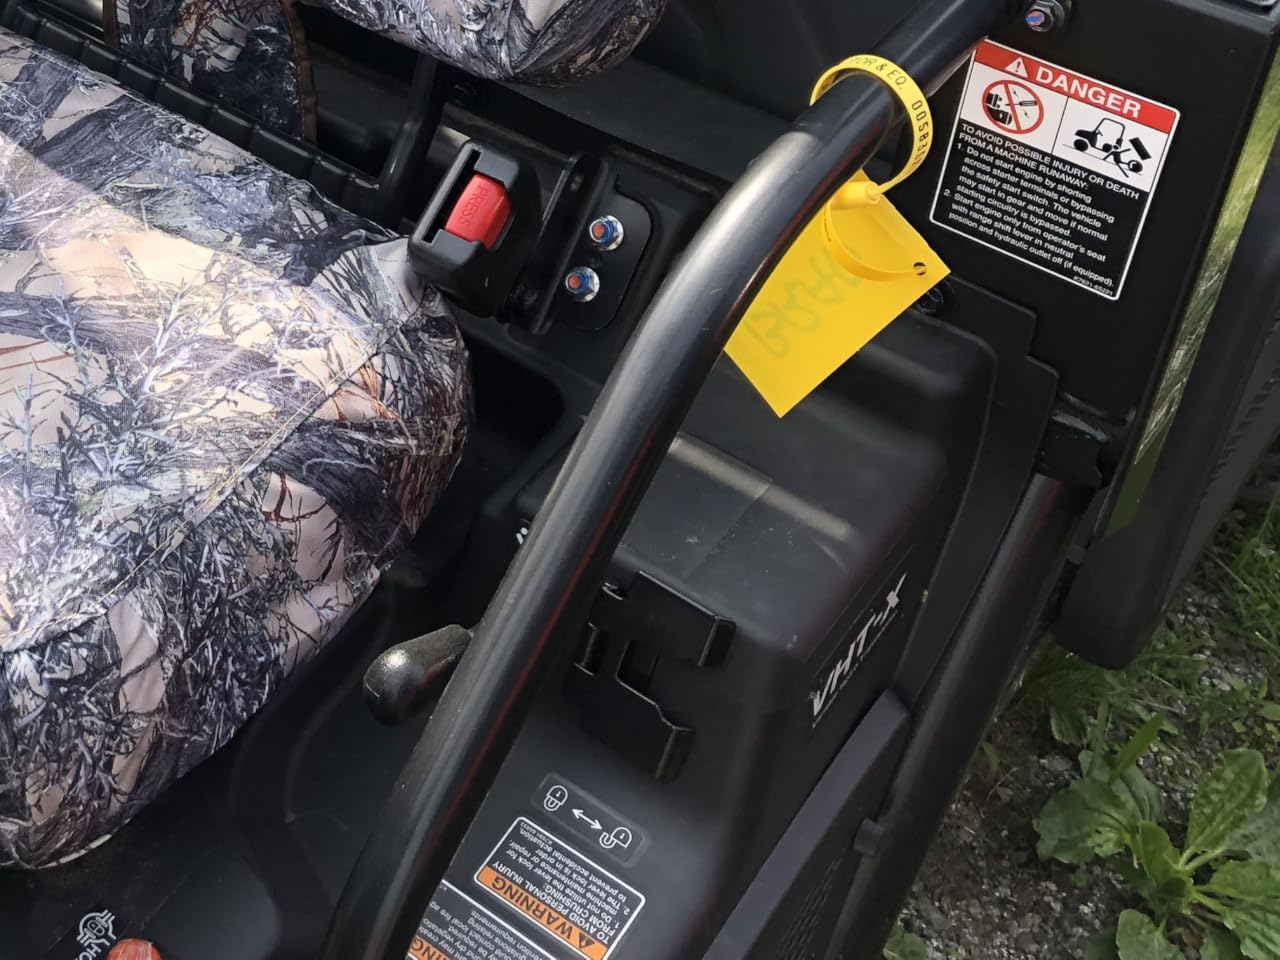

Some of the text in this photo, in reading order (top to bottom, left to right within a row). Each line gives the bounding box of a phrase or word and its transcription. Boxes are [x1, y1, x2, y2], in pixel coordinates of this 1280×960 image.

[1036, 65, 1141, 118] DANGER
[958, 132, 1089, 190] FROM A MACHINE RUNAWAY:
[962, 123, 1140, 200] TO AVOID POSSIBLE INJURY OR DEATH
[966, 146, 980, 157] Do
[979, 152, 995, 163] not
[994, 158, 1014, 172] start
[1014, 166, 1044, 183] engine
[1044, 177, 1056, 189] by
[1056, 183, 1093, 204] shorting
[961, 165, 1102, 228] the safety start switch. The vehicle
[963, 156, 1115, 224] across starter terminals or bypassing
[458, 185, 489, 225] PRESS
[956, 184, 1072, 237] starting circuitry is bypassed.
[958, 175, 1109, 242] may start in gear and move if normal
[951, 202, 1075, 259] with range shift lever in neutral
[953, 192, 974, 207] Start
[974, 202, 1003, 219] engine
[1002, 214, 1022, 227] only
[1022, 221, 1042, 236] from
[1042, 231, 1086, 254] operator's
[1086, 249, 1107, 263] seat
[948, 212, 1114, 287] position and hydraulic outlet off (if equipped).
[505, 848, 518, 860] for
[517, 855, 534, 871] lock
[517, 825, 627, 903] to prevent accidental actuation.
[534, 848, 556, 864] order
[555, 861, 564, 871] in
[508, 839, 618, 916] machine maintenance or repair.
[532, 867, 553, 883] lever
[563, 866, 572, 876] is
[571, 871, 589, 887] lock
[552, 879, 565, 891] the
[564, 887, 588, 906] utilize
[587, 883, 608, 900] lever
[439, 908, 453, 921] fire
[492, 860, 610, 945] TO AVOID PERSONAL INJURY
[492, 875, 573, 940] WARNING
[542, 882, 616, 937] FROM CRUSHING:
[586, 902, 601, 915] not
[606, 896, 622, 911] The
[450, 917, 470, 934] local
[467, 916, 495, 940] relating
[470, 910, 517, 945] requirements.
[600, 911, 613, 924] Do
[422, 918, 455, 944] vegetatio
[468, 929, 495, 951] contact
[438, 939, 455, 955] may
[454, 940, 467, 952] dry
[477, 946, 488, 958] be
